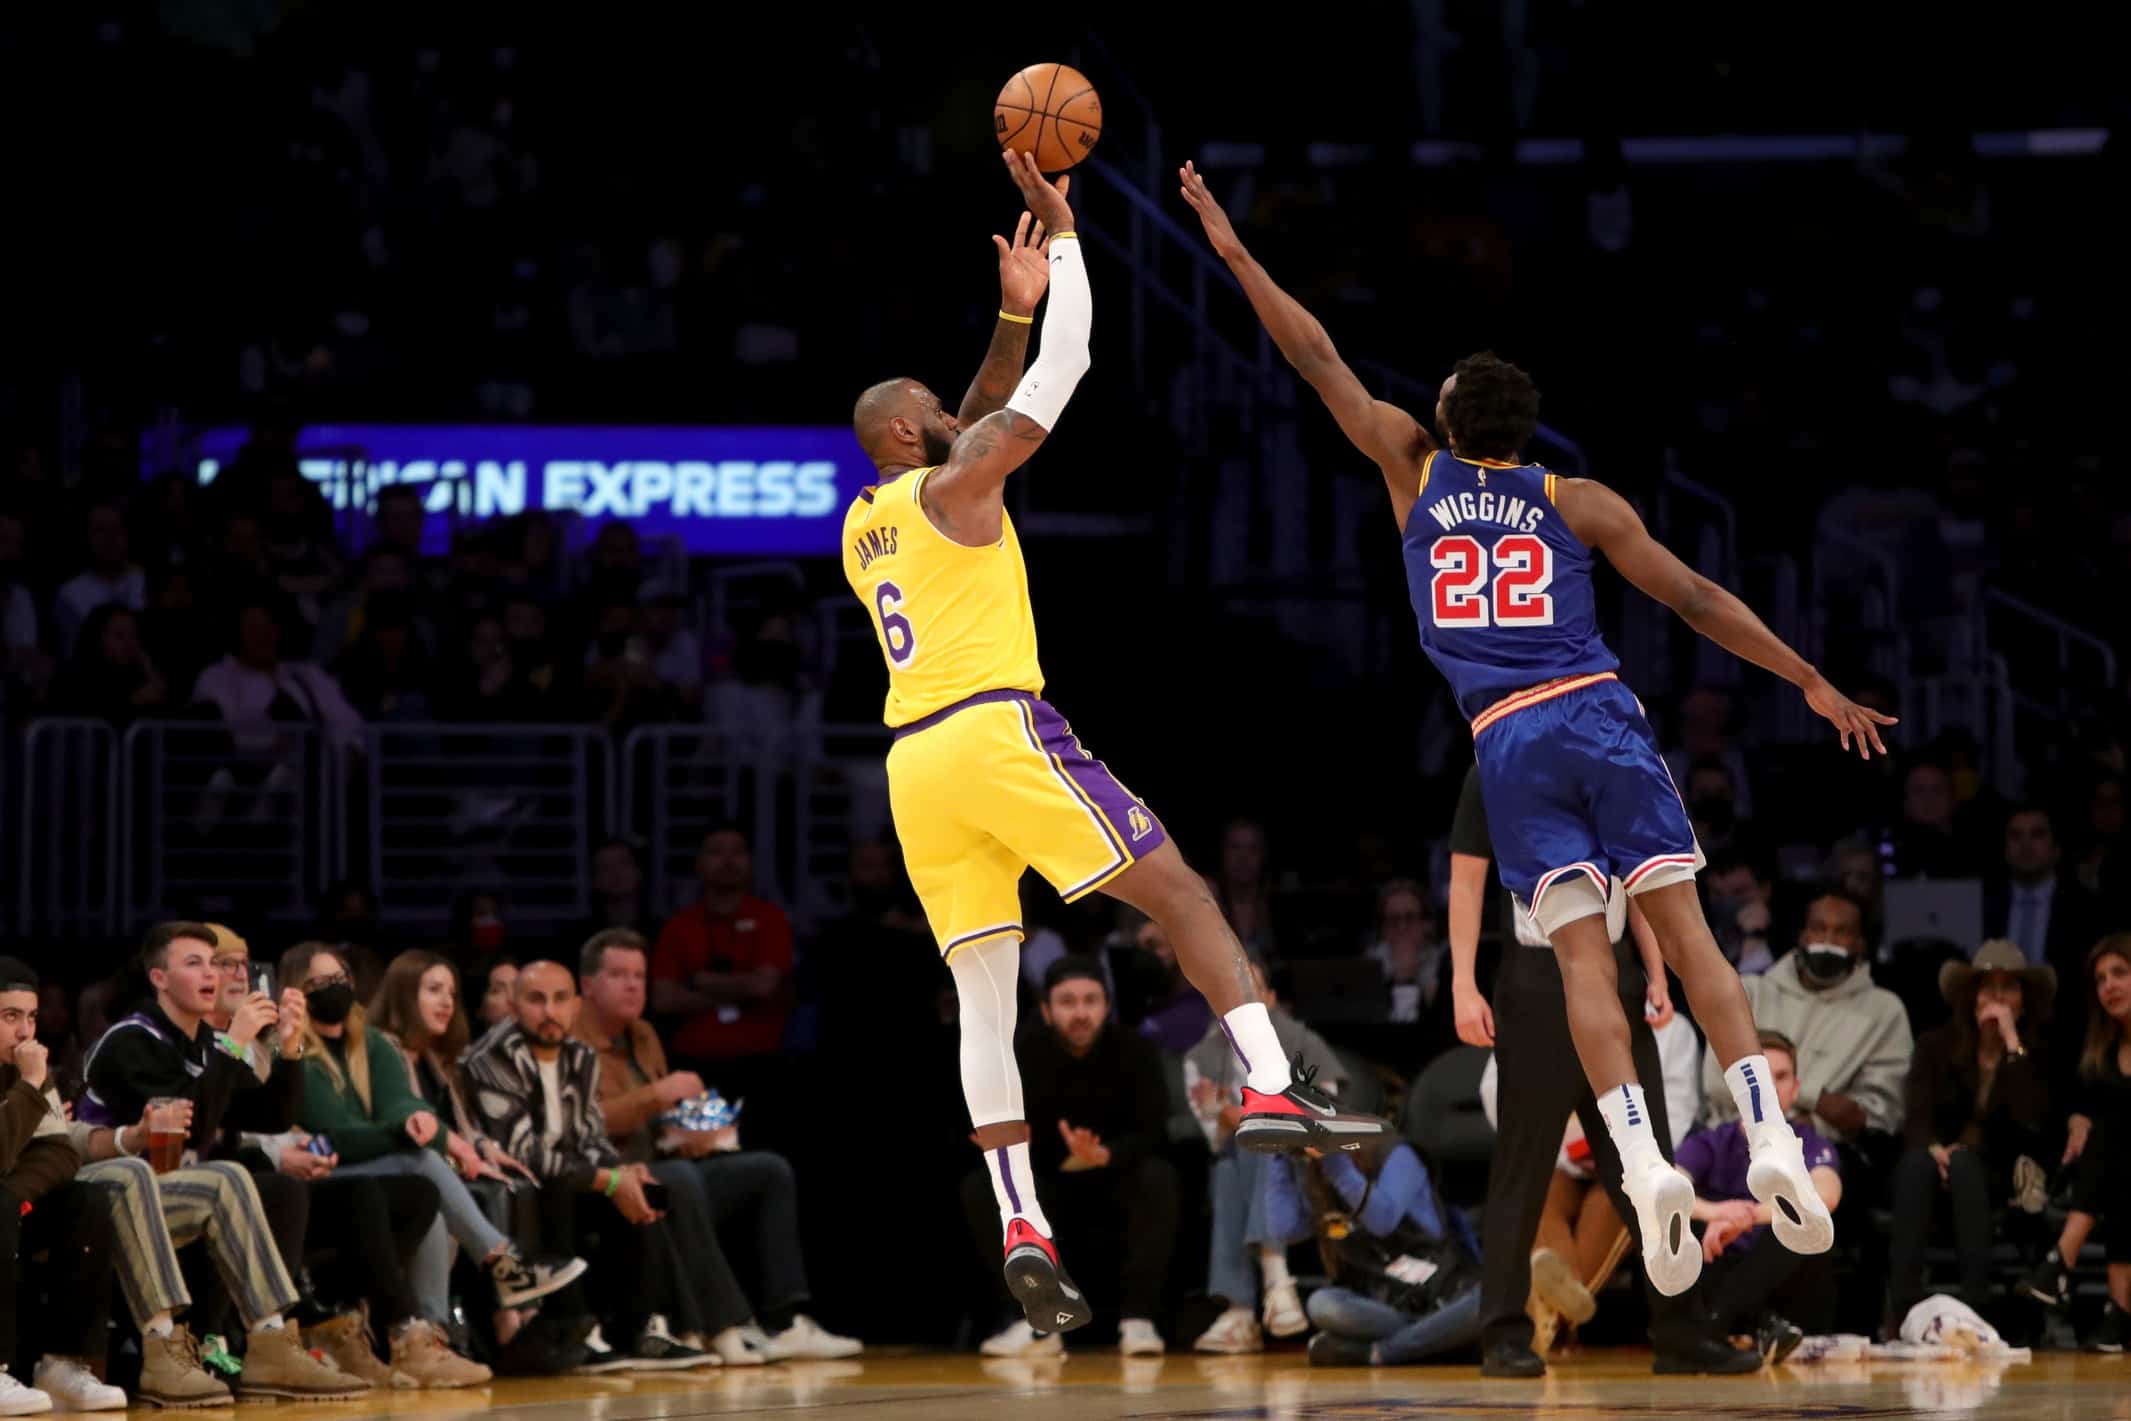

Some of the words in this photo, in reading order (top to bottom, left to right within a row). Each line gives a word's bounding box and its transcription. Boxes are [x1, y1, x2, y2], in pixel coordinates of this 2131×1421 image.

[544, 459, 837, 518] EXPRESS
[1428, 492, 1544, 533] WIGGINS
[854, 526, 898, 571] JAMES
[1430, 534, 1554, 628] 22
[876, 578, 917, 670] 6
